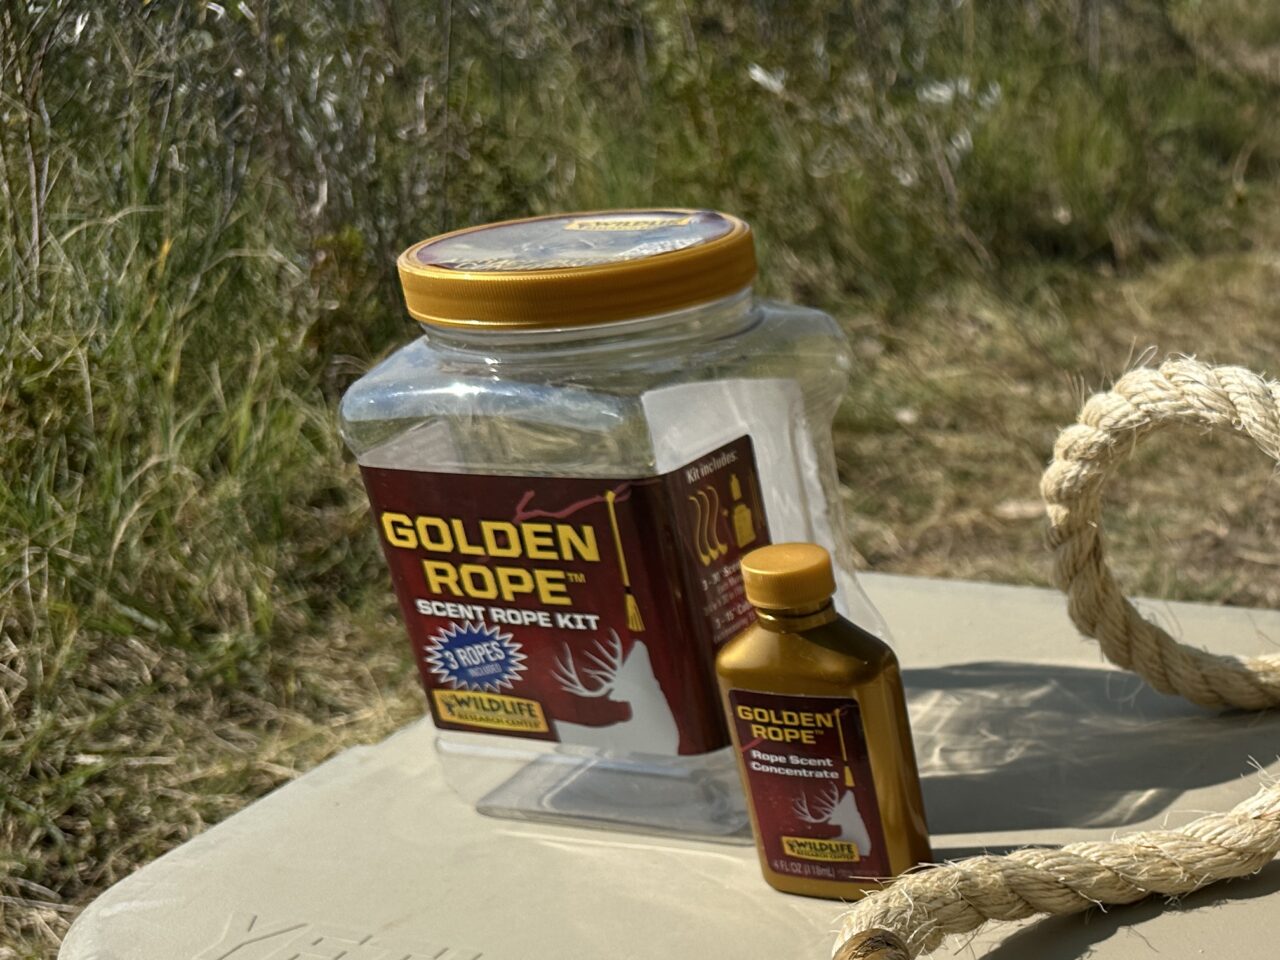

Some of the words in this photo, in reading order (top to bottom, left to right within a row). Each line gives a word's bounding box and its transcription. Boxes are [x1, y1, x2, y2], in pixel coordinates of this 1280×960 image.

[686, 467, 700, 485] Kit
[381, 512, 600, 562] GOLDEN
[415, 599, 487, 623] SCENT
[491, 608, 553, 627] ROPE
[556, 612, 600, 631] KIT
[444, 651, 460, 670] 3
[457, 640, 506, 667] ROPES
[453, 695, 537, 719] WILDLIFE
[737, 705, 834, 728] GOLDEN
[751, 749, 787, 763] Rope
[789, 755, 834, 767] Scent
[751, 761, 839, 779] Concentrate
[795, 841, 854, 854] WILDLIFE
[791, 862, 802, 874] OZ
